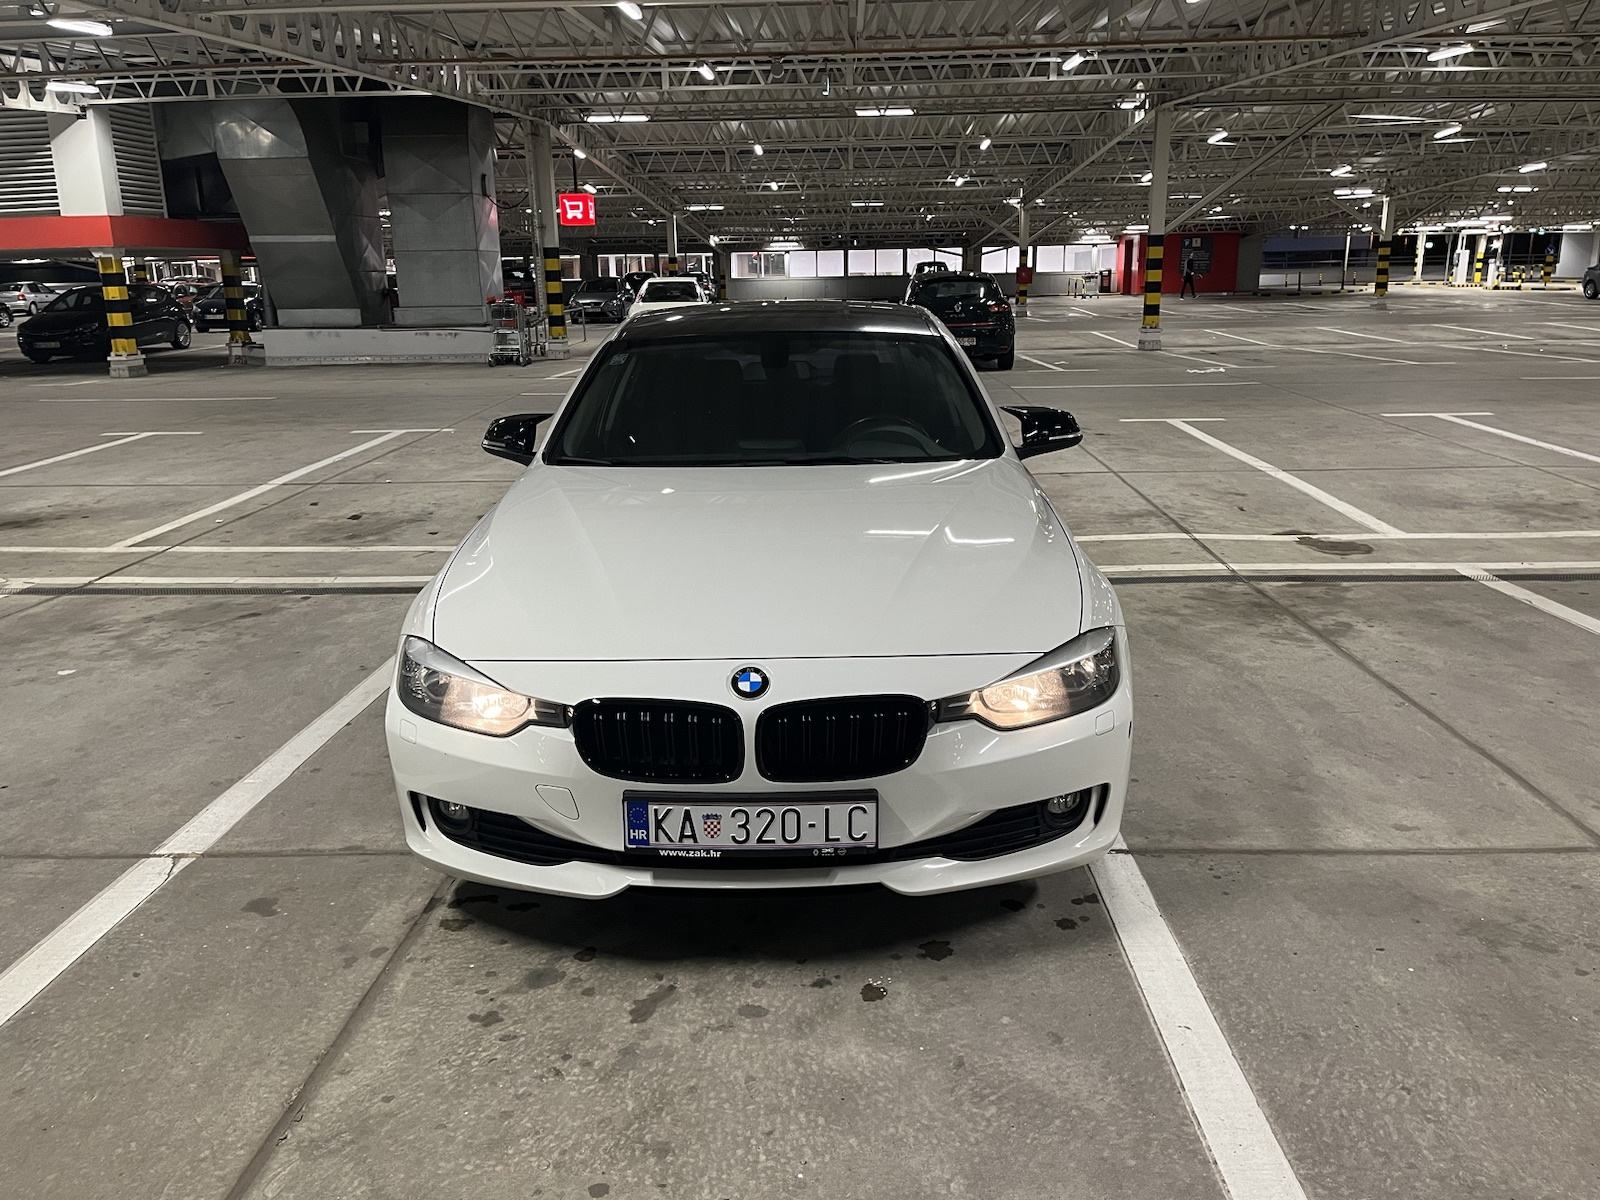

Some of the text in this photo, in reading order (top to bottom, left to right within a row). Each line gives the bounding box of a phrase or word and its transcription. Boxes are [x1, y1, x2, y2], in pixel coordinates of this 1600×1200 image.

[653, 804, 868, 844] KA 320-LC
[630, 829, 648, 841] HR
[659, 849, 722, 858] www.zak.hr
